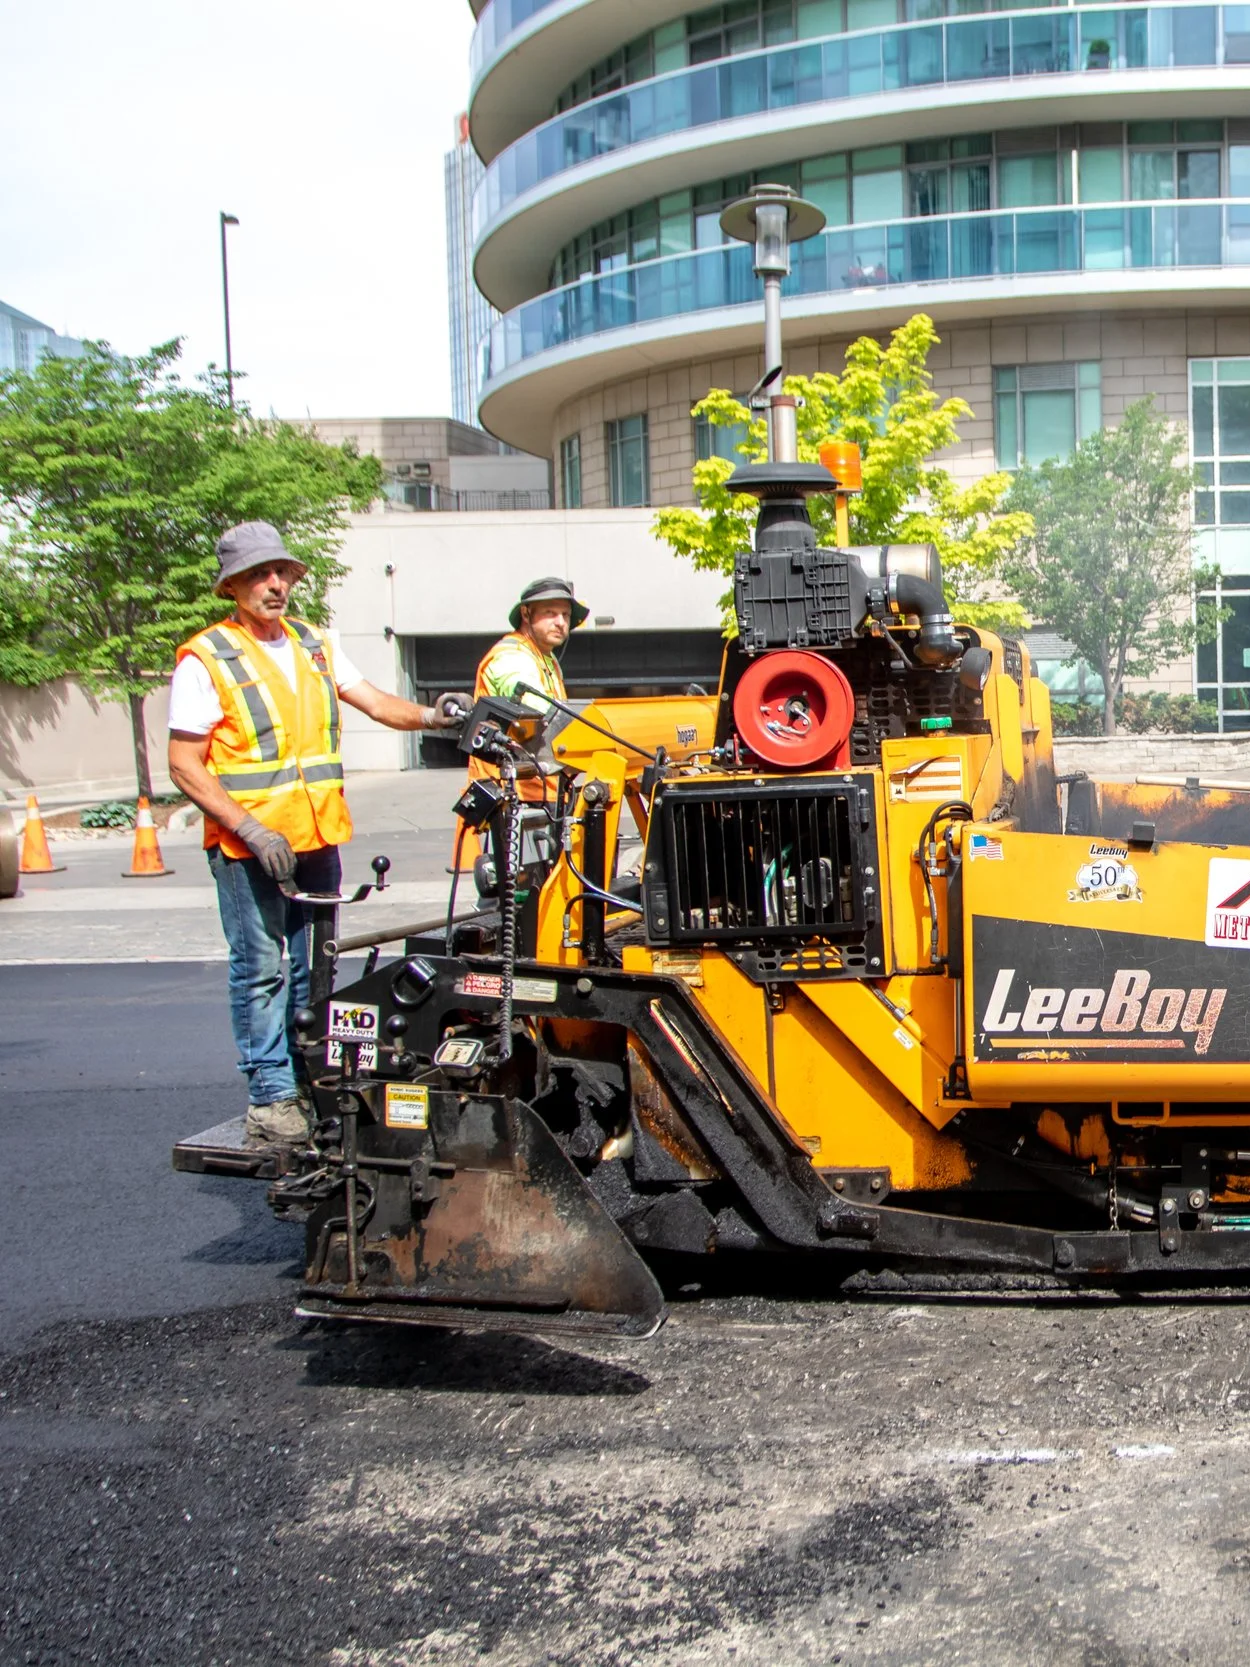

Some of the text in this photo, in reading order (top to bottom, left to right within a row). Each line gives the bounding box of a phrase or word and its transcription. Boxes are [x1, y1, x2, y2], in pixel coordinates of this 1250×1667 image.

[1090, 844, 1128, 859] LeeBoy
[472, 981, 501, 989] PELGRO
[983, 969, 1228, 1056] LeeBoy
